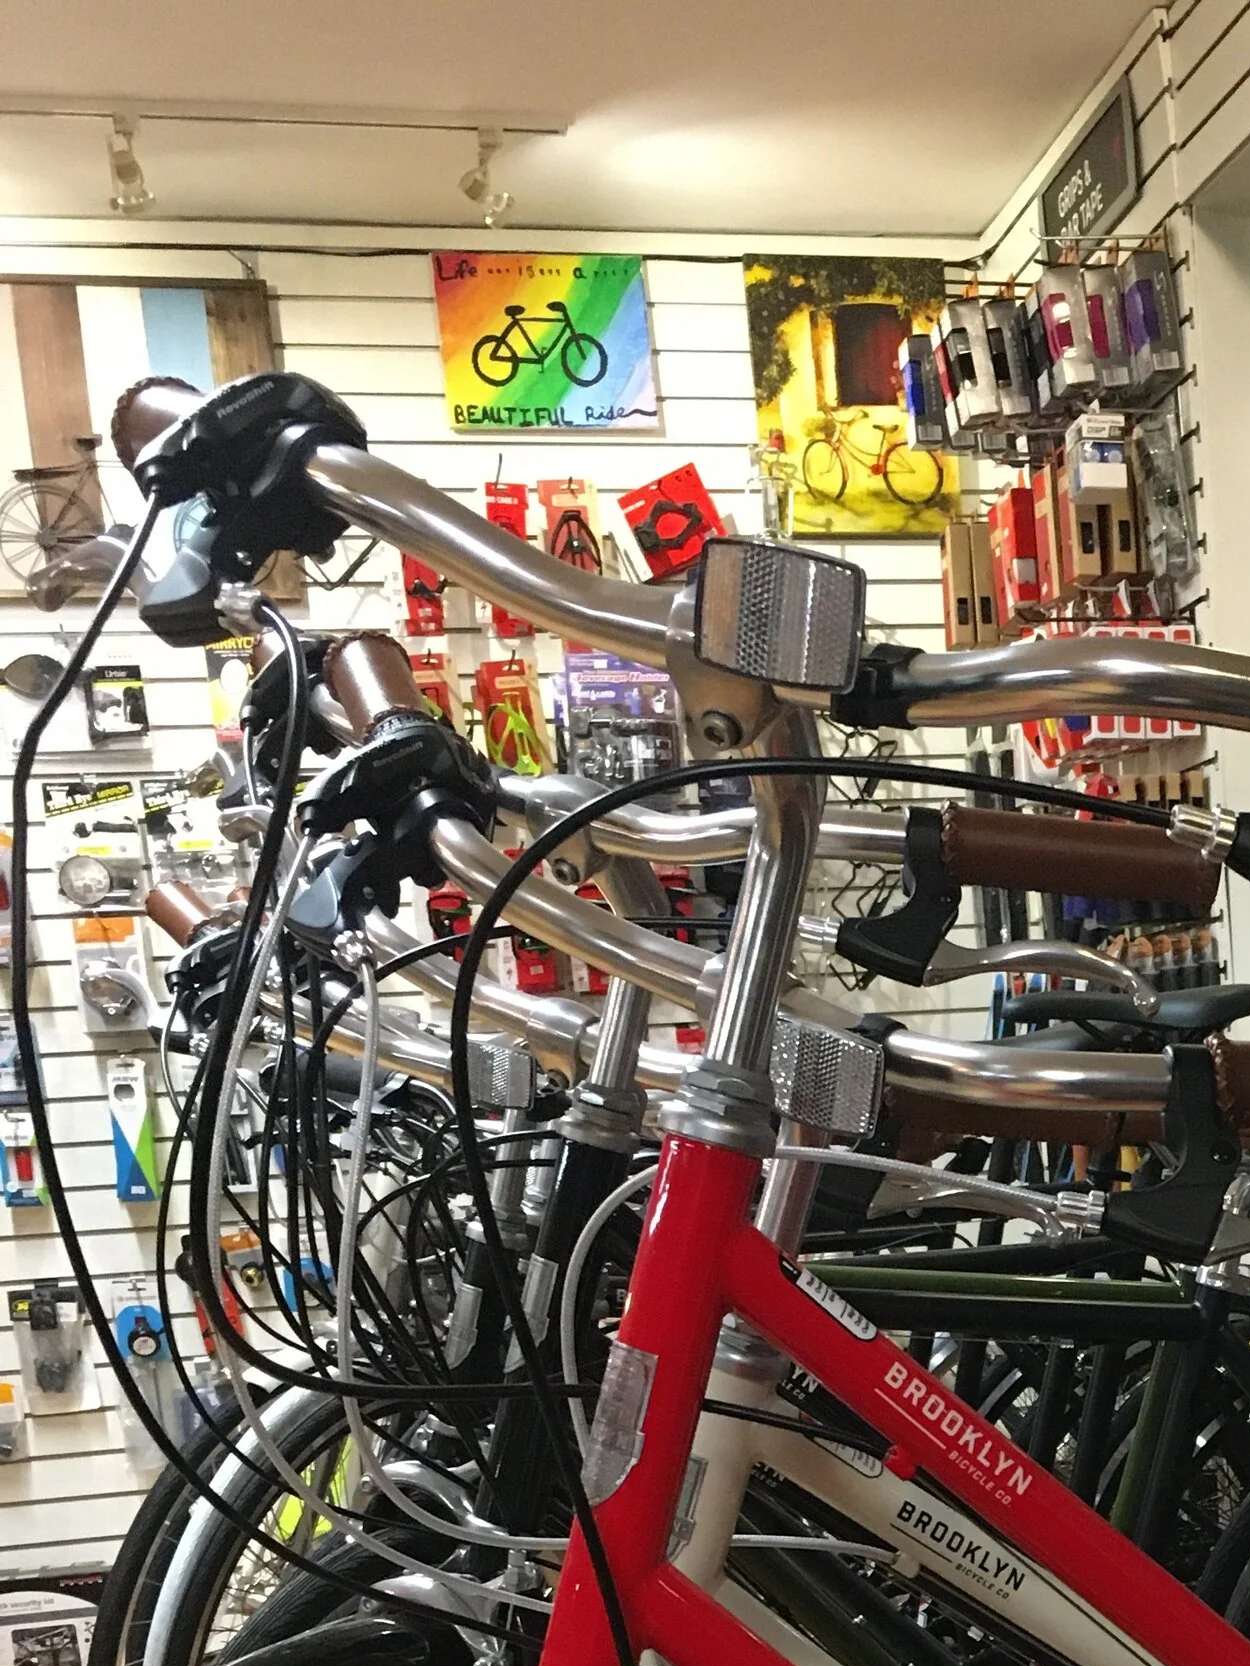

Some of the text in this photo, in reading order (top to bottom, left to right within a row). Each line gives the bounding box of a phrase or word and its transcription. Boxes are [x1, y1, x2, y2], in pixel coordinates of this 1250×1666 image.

[1058, 168, 1084, 218] GRIPS
[1080, 183, 1103, 229] TAPE
[454, 403, 574, 428] BEAUTIFUL
[884, 1361, 1033, 1496] BROOKLYN
[948, 1449, 995, 1492] BICYCLE
[896, 1500, 1026, 1592] BROOKLYN
[955, 1562, 996, 1592] BICYCLE
